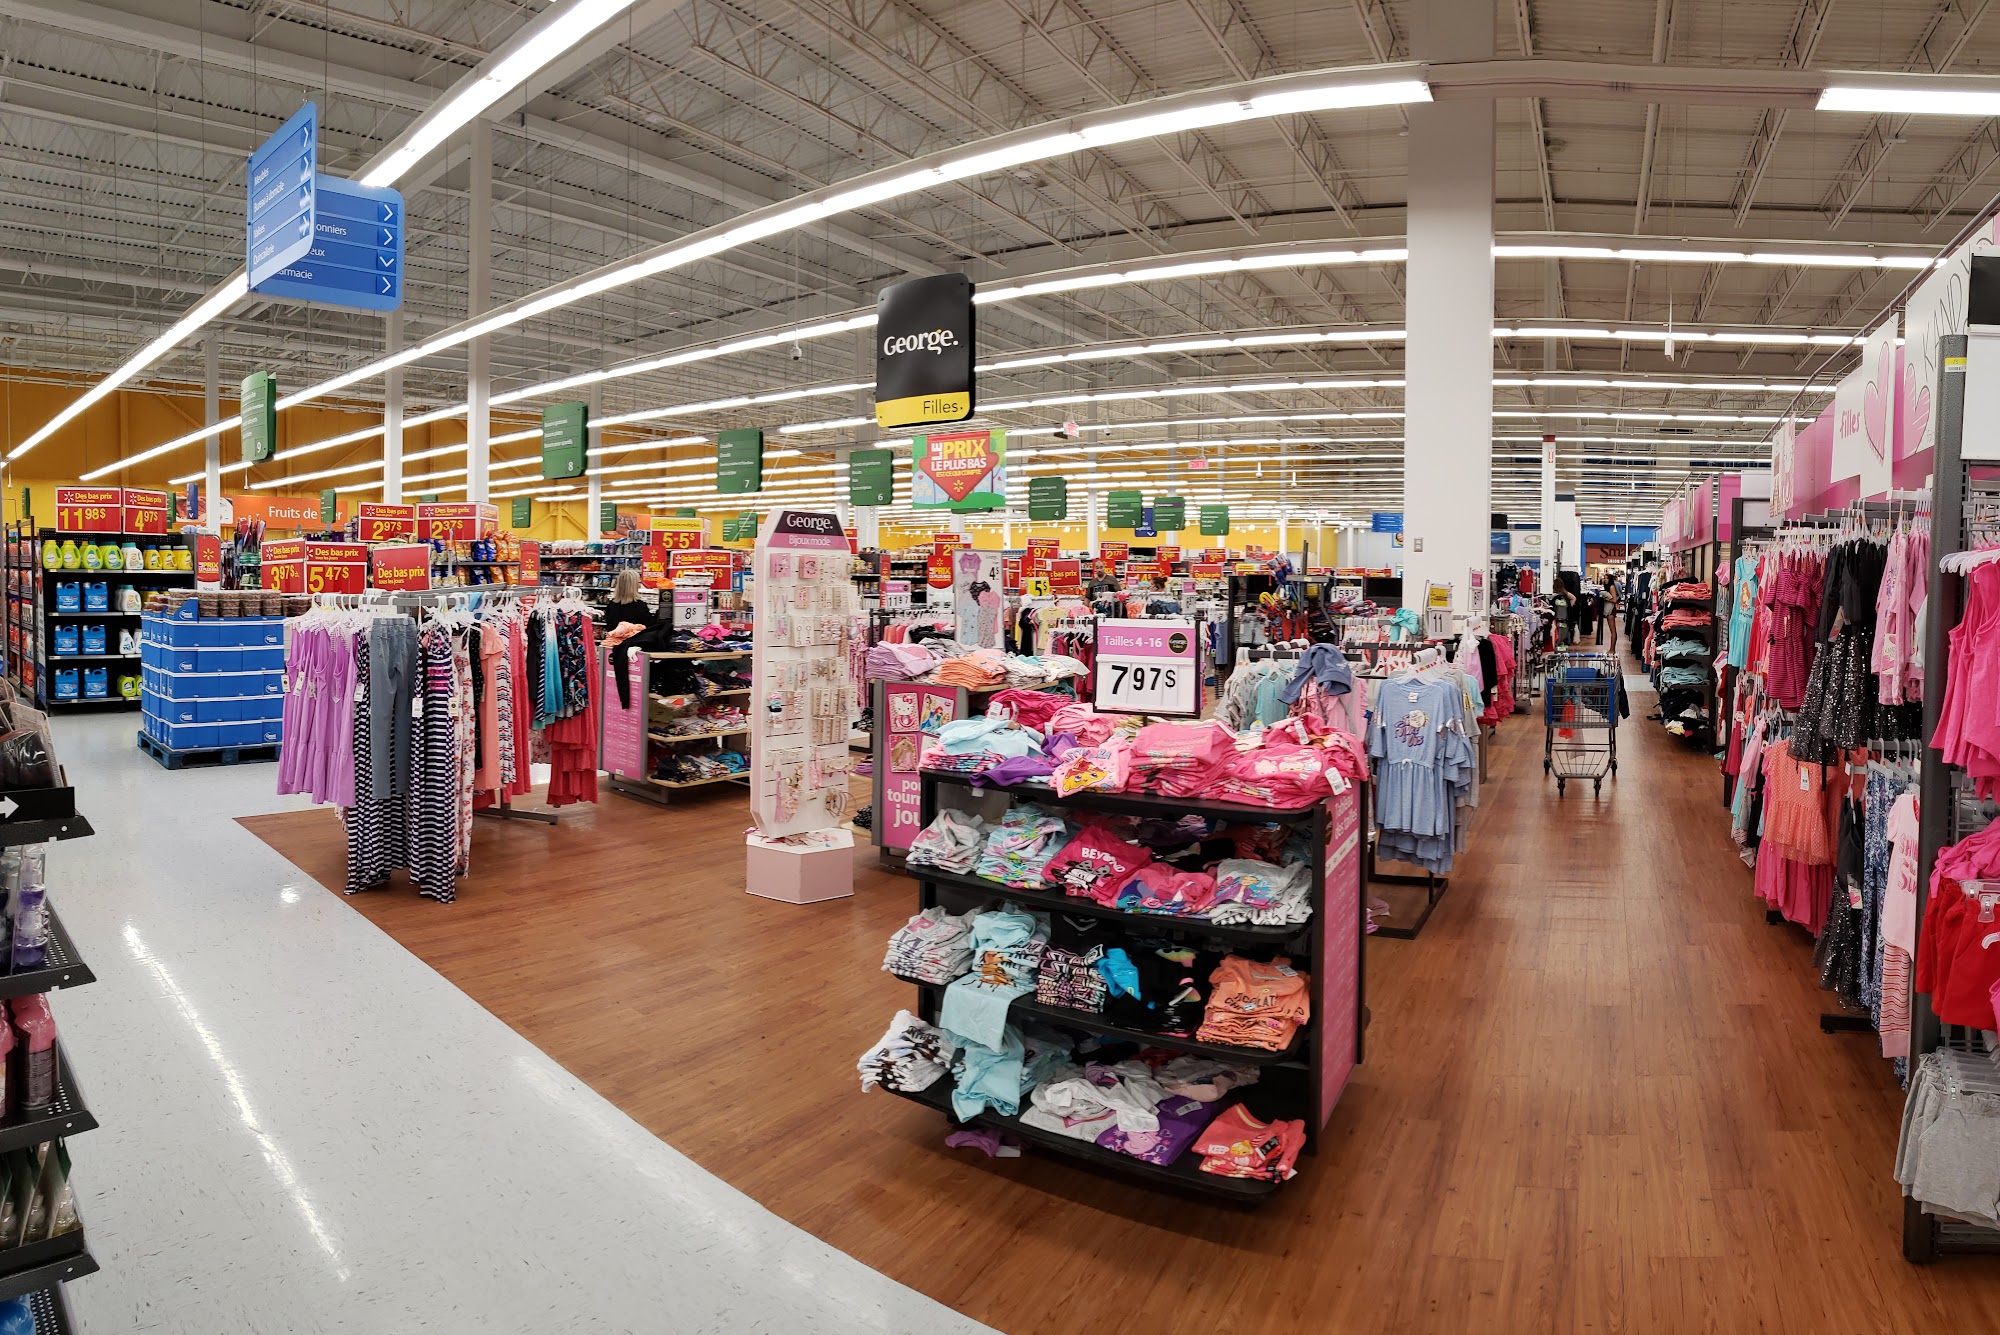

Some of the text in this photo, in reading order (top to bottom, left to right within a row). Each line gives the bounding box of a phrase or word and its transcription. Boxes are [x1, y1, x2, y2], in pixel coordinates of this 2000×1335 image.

[316, 223, 347, 236] onniers
[308, 247, 325, 257] eux
[277, 268, 313, 280] armacie
[1840, 409, 1860, 439] filles
[256, 441, 262, 454] 9
[931, 438, 987, 461] LE PRIX
[568, 461, 574, 472] 8
[931, 458, 987, 472] LE PLUS BAS
[744, 479, 750, 488] 7
[75, 492, 87, 500] Des
[88, 492, 99, 500] bas
[100, 493, 113, 501] prix
[153, 496, 162, 504] prix
[877, 493, 884, 501] 6
[268, 506, 343, 521] Fruits de er
[396, 508, 408, 516] prix
[458, 506, 470, 514] prix
[788, 534, 831, 547] Bijoux mode
[273, 544, 300, 555] Des bas prix
[315, 548, 359, 558] Des bas prix
[647, 562, 665, 572] PRIX
[933, 567, 951, 575] PRIX
[377, 566, 426, 580] Des bas prix
[1054, 570, 1078, 578] bas prix
[1103, 635, 1134, 647] Tailles
